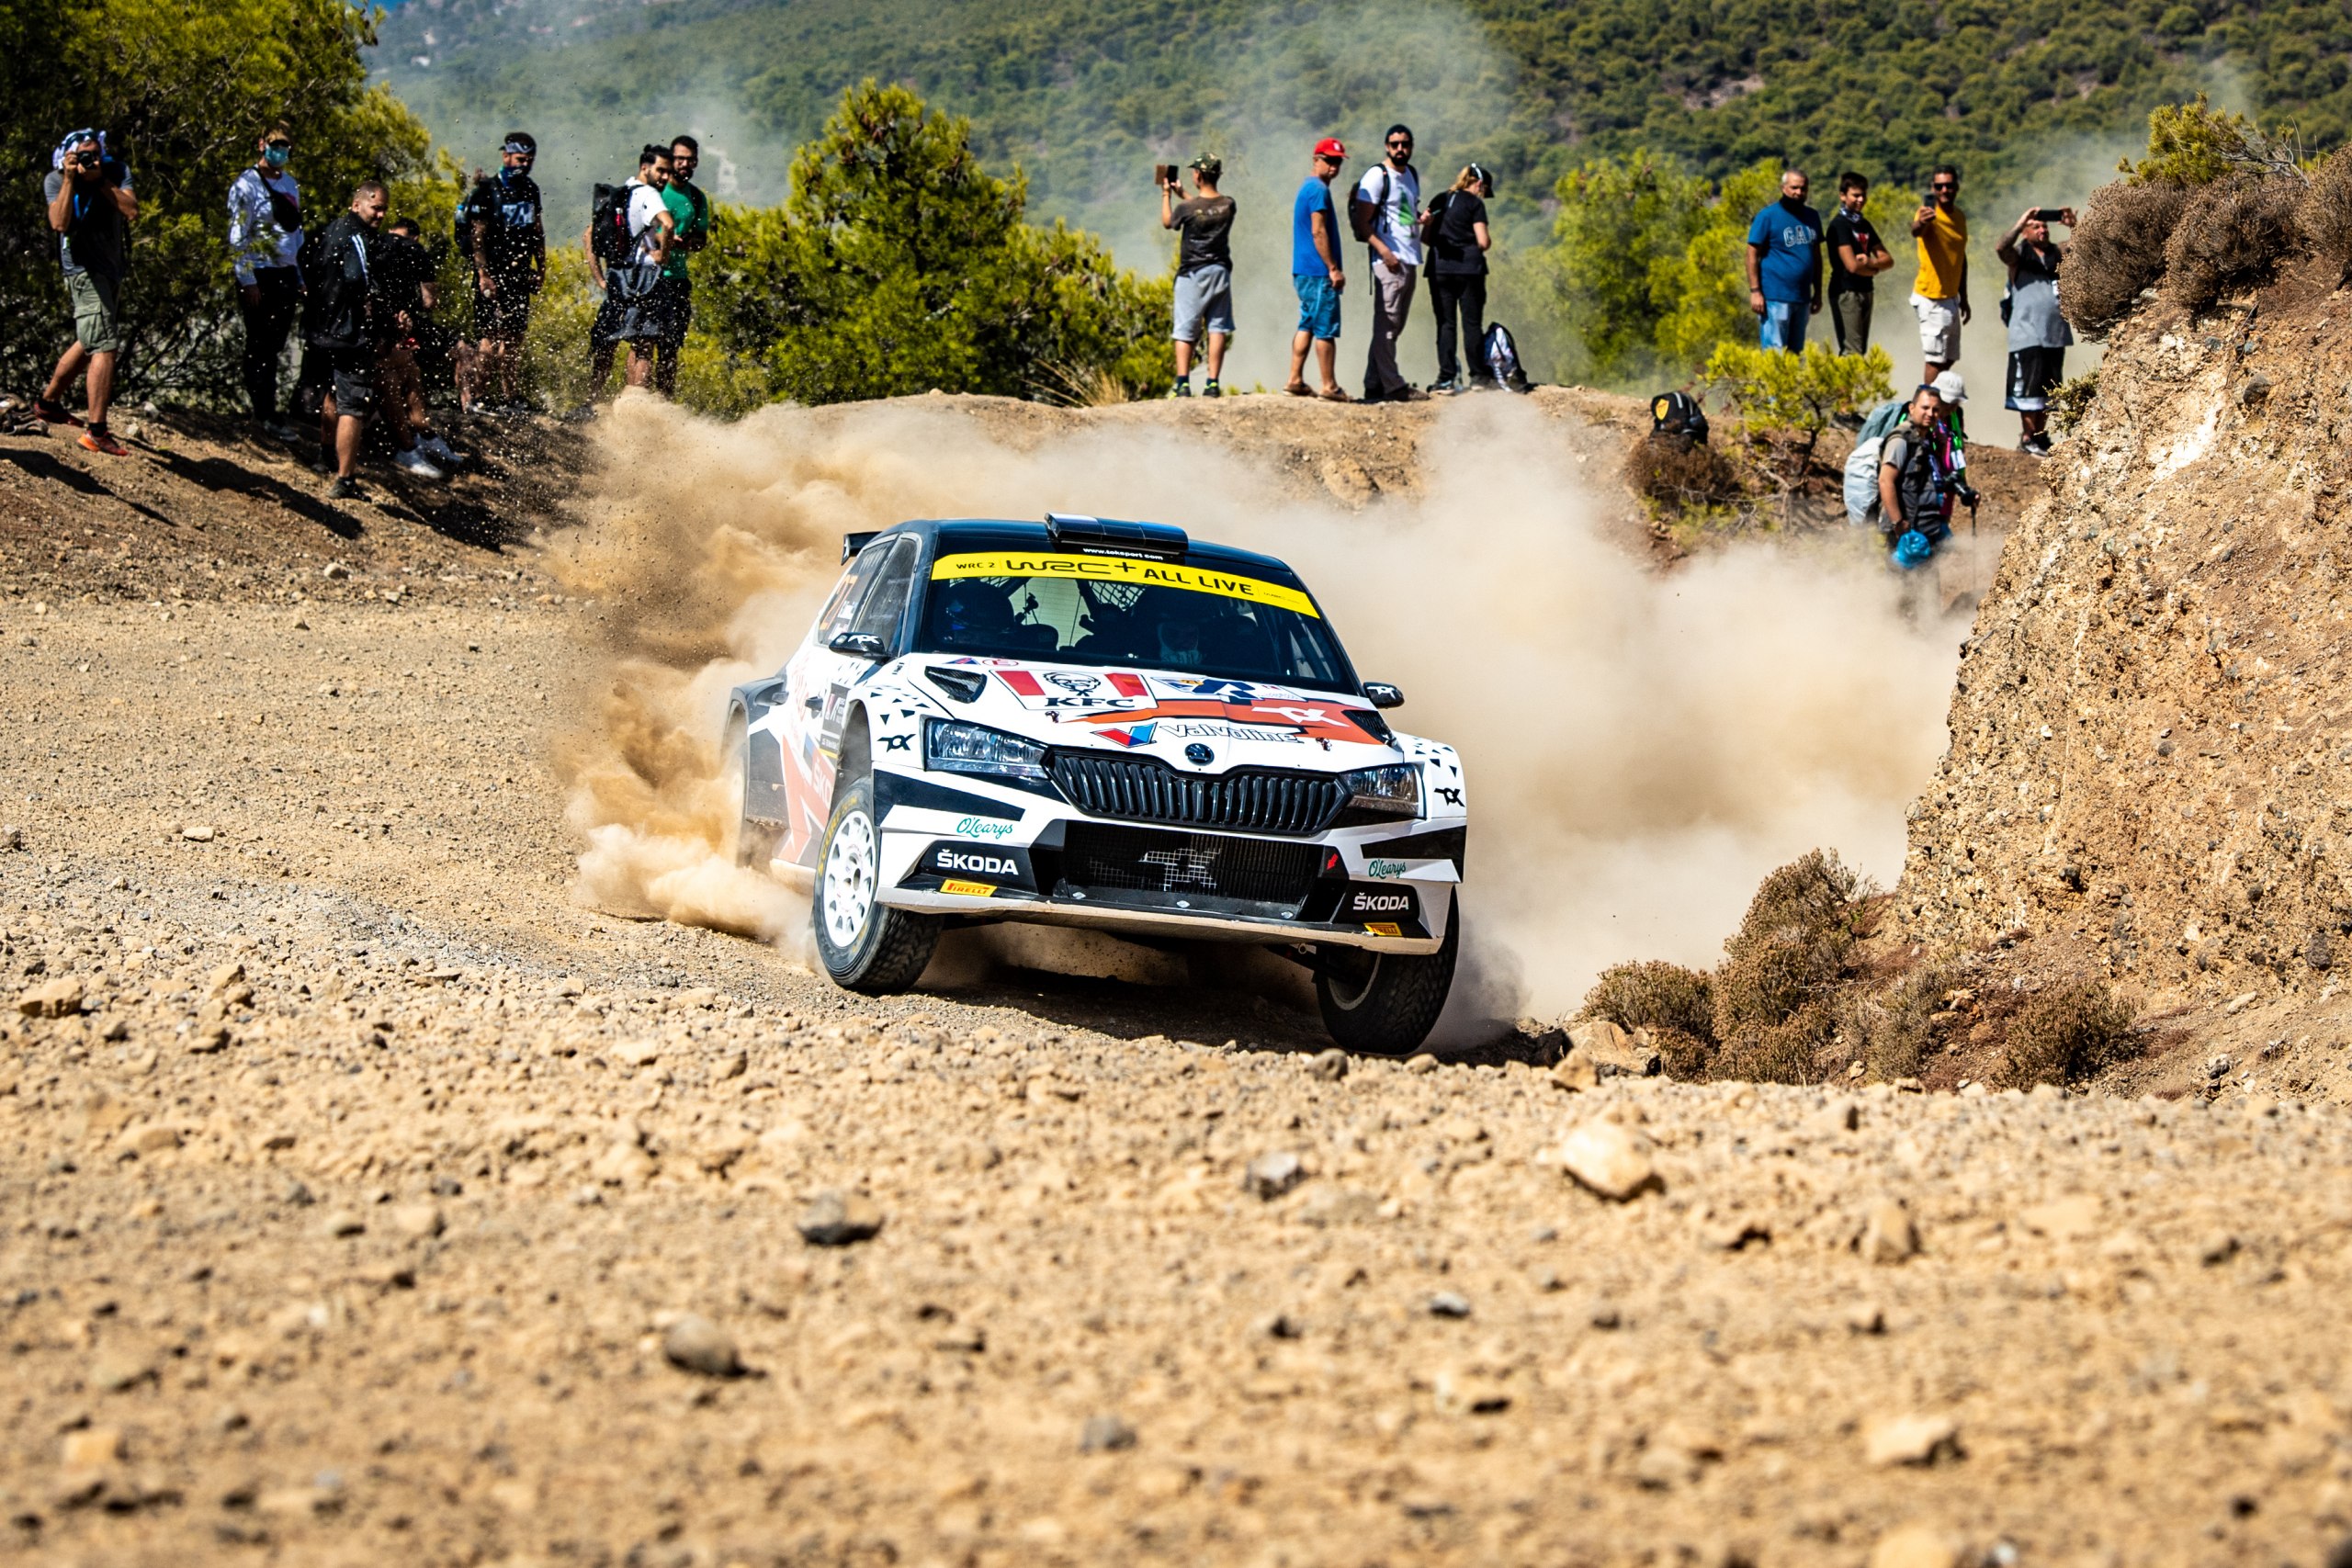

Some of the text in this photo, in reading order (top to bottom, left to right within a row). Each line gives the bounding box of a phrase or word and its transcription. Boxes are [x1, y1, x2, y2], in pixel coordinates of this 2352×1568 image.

[1082, 547, 1164, 561] www.toksportcom
[956, 561, 984, 570] WRC
[1144, 568, 1192, 585] ALL
[1198, 575, 1254, 596] LIVE
[1044, 696, 1136, 708] KFC
[1159, 724, 1303, 744] Valvoline
[956, 817, 1013, 840] O'Learys
[936, 848, 1019, 875] ŠKODA
[1368, 858, 1408, 879] O'Learys
[946, 882, 990, 895] PIRELLI
[1352, 892, 1409, 911] ŠKODA
